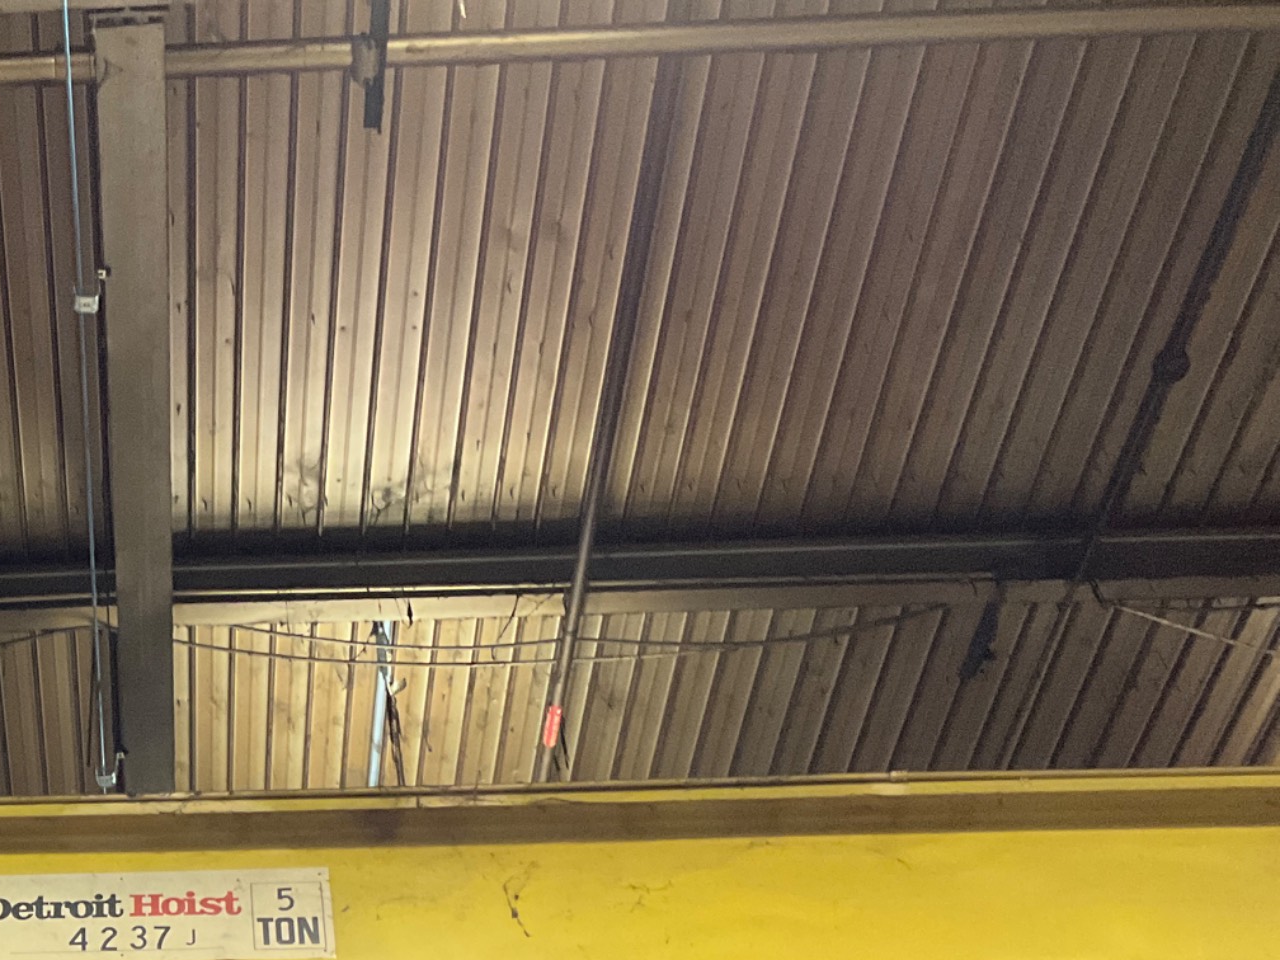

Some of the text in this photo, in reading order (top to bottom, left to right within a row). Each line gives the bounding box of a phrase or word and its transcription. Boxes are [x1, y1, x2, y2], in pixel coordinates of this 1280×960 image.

[129, 891, 241, 917] Hoist
[277, 888, 295, 911] 5
[69, 926, 172, 951] 4237
[257, 916, 320, 946] TON
